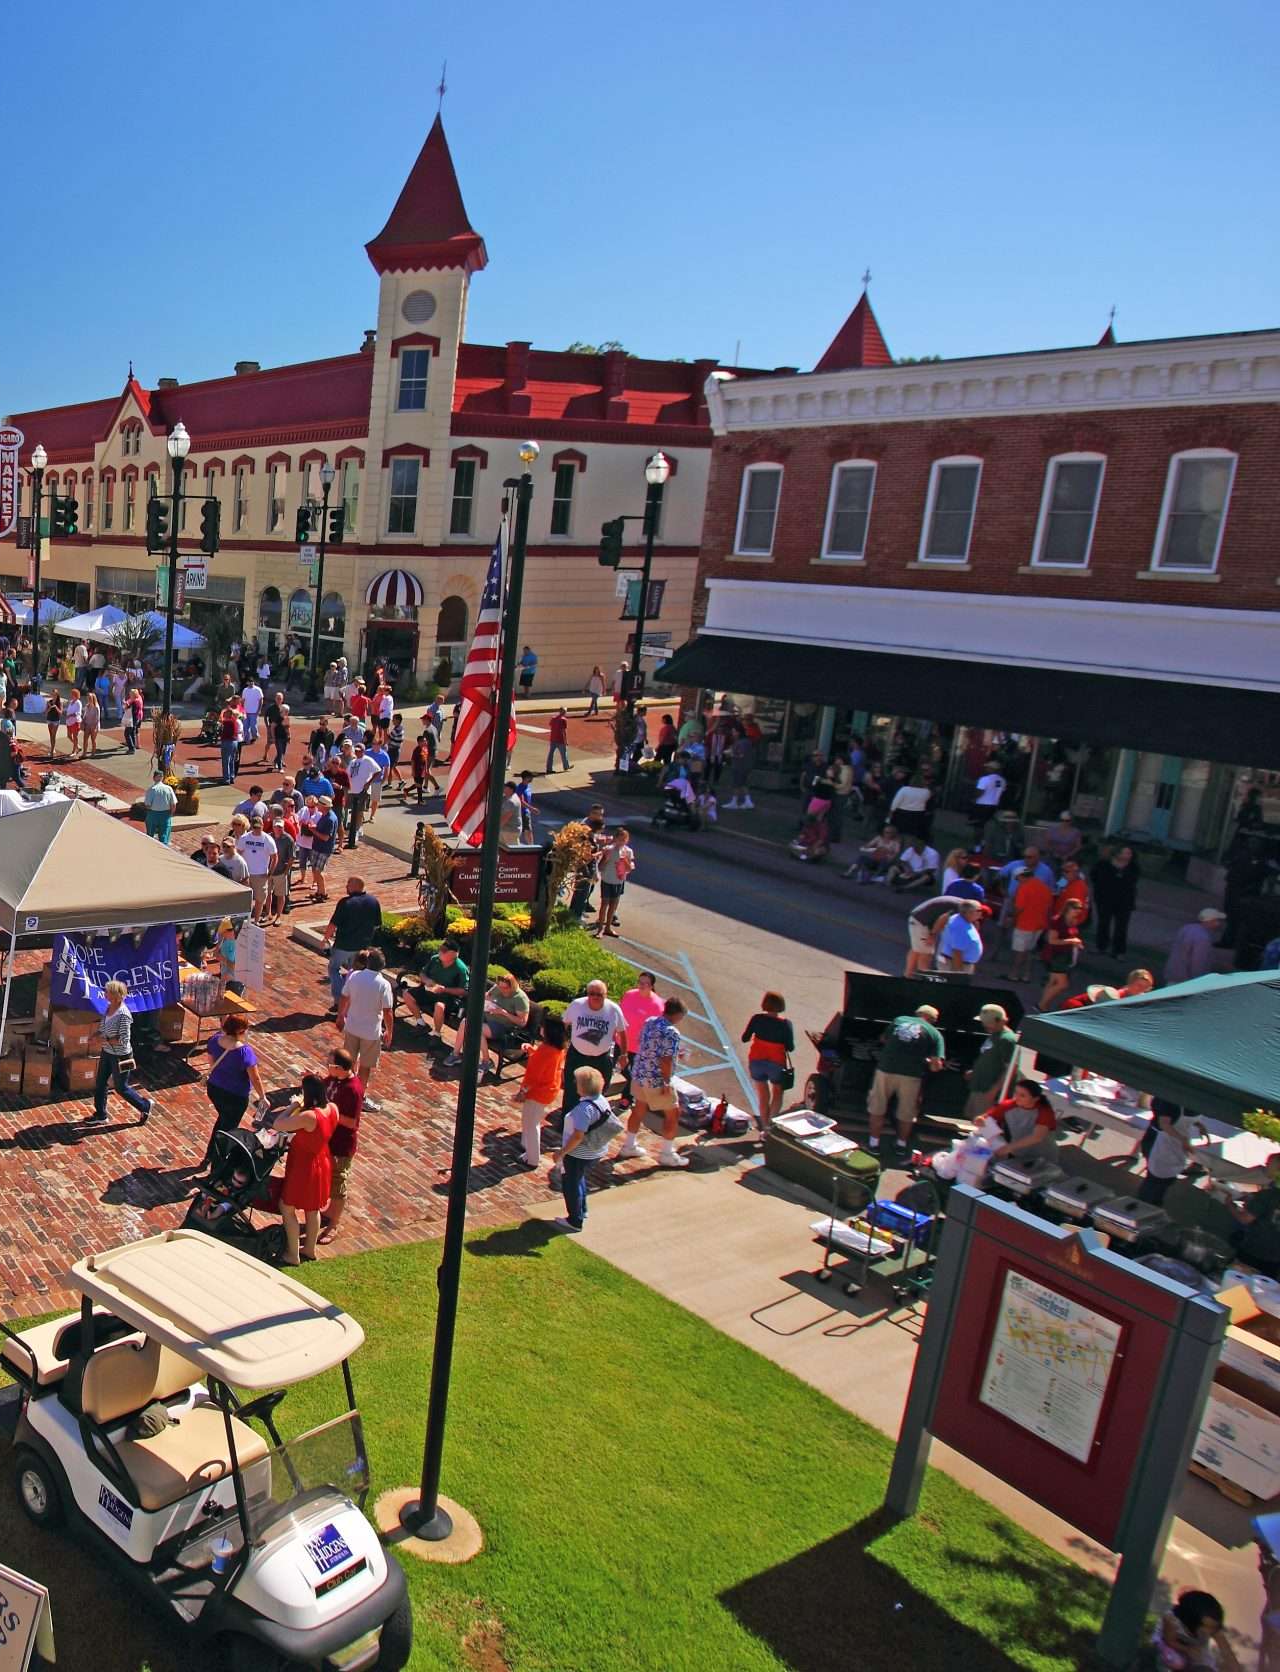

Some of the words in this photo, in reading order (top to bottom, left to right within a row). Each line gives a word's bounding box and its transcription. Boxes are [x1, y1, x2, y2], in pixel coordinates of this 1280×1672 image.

[1, 451, 14, 527] MARKET
[186, 572, 205, 587] ARKING
[61, 960, 174, 999] HUDGENS
